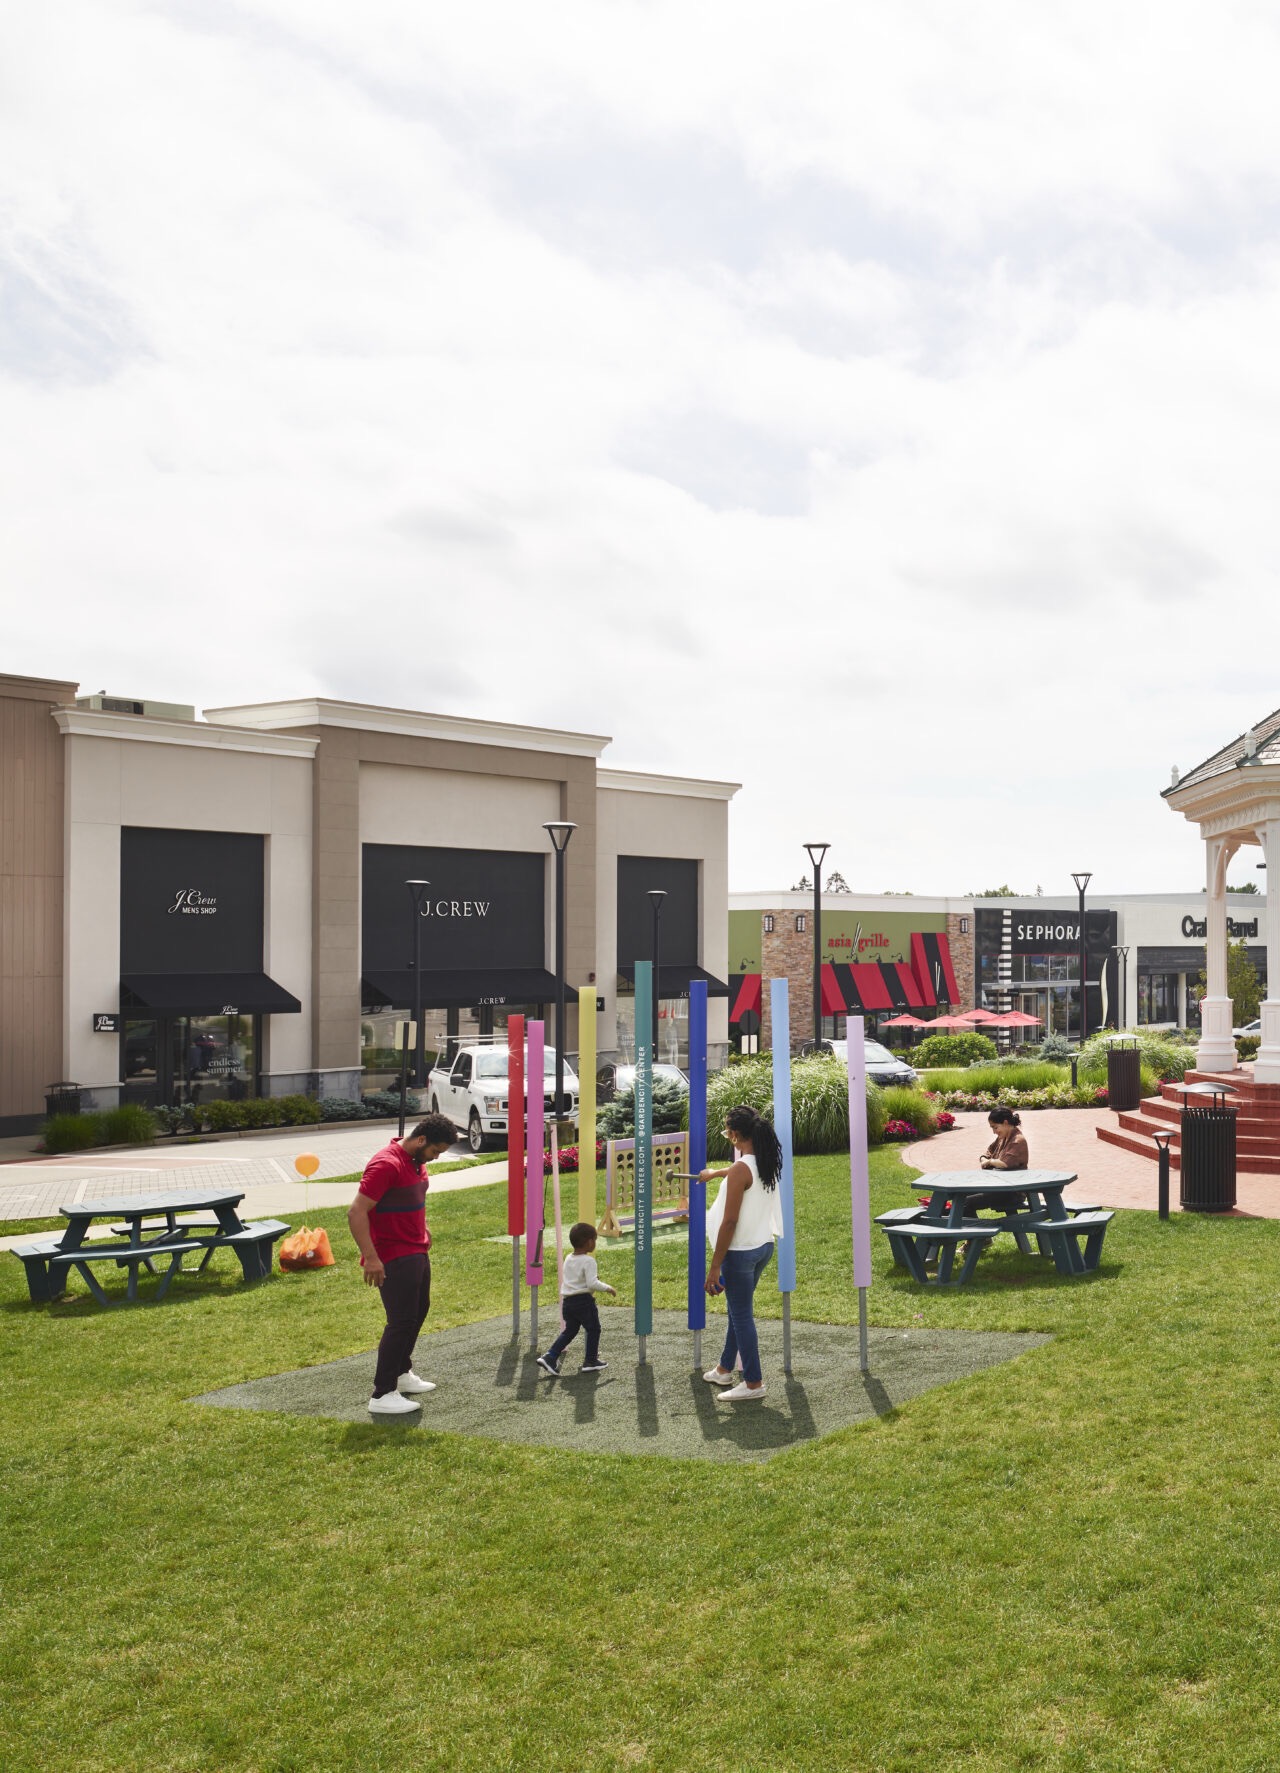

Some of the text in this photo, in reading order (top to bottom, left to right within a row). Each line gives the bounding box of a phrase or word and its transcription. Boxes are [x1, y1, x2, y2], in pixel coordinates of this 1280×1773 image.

[168, 889, 217, 914] J.Crew
[421, 901, 490, 917] J.CREW
[1018, 925, 1080, 940] SEPHORA
[1182, 915, 1207, 938] Cra
[828, 933, 890, 952] asia grille
[478, 997, 506, 1005] J.CREW
[208, 1058, 241, 1066] endless
